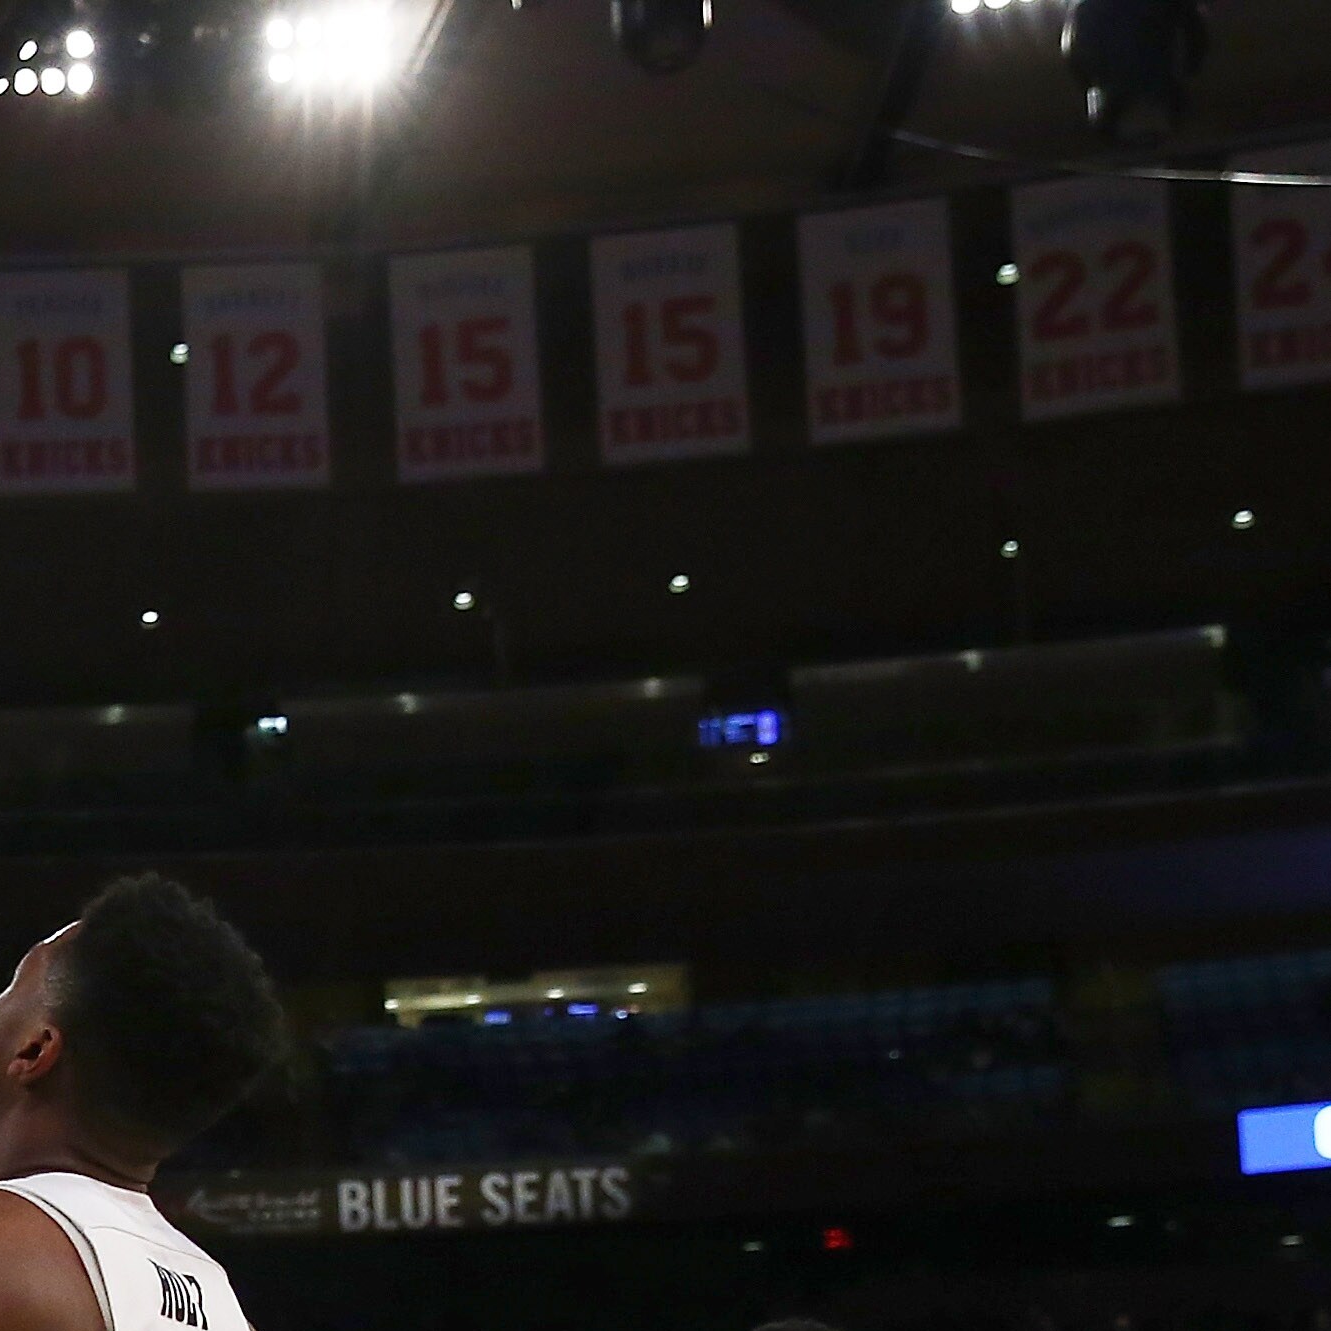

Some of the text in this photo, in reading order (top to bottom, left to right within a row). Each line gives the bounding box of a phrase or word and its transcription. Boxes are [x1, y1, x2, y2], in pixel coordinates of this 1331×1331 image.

[1029, 241, 1159, 341] 22
[1250, 217, 1331, 310] 2
[417, 315, 514, 406] 15
[622, 293, 720, 387] 15
[830, 274, 930, 366] 19
[15, 335, 108, 422] 10
[211, 331, 303, 417] 12
[0, 438, 128, 478] KNICKS
[196, 435, 324, 474] KNICKS
[404, 418, 534, 463] KNICKS
[338, 1174, 464, 1232] BLUE
[480, 1166, 631, 1221] SEATS
